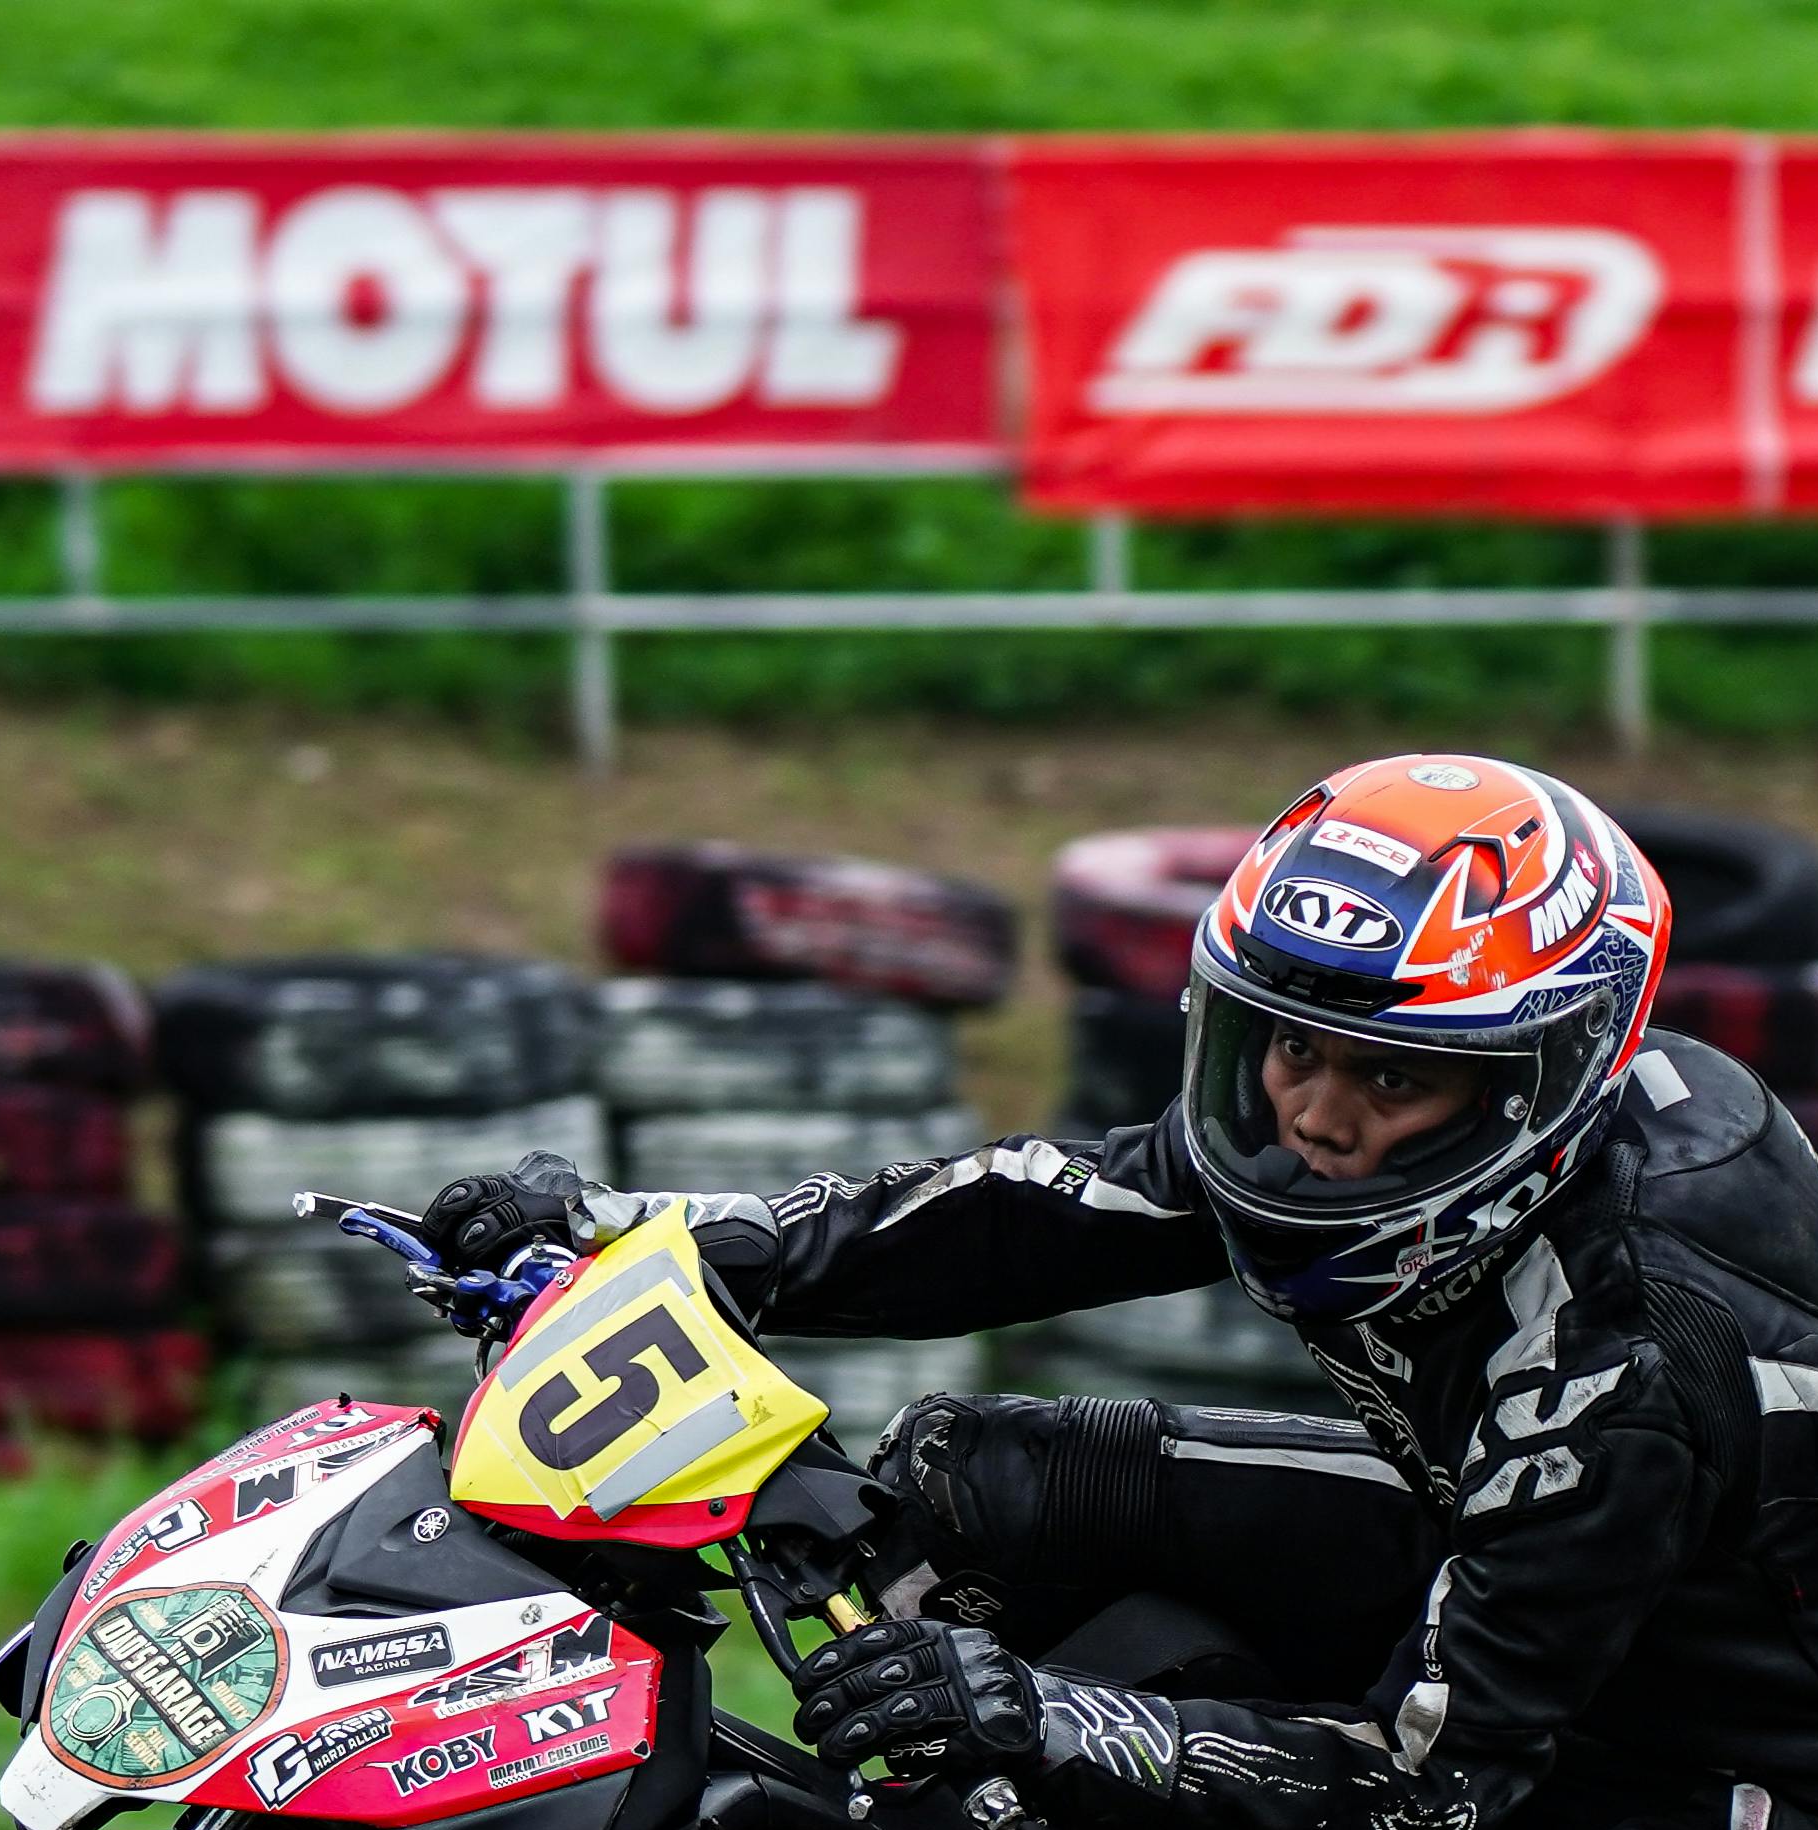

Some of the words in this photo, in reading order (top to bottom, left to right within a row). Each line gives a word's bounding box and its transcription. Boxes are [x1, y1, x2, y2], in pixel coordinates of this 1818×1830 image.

[29, 186, 904, 413] MOTUL
[1271, 883, 1390, 939] KYT
[520, 1304, 709, 1471] 5
[317, 1631, 447, 1673] NAMSSA
[354, 1658, 411, 1676] RACING
[134, 1654, 227, 1747] GARAGE
[519, 1685, 620, 1743] KYT
[313, 1745, 347, 1772] HARD
[349, 1724, 387, 1750] ALLOY
[392, 1727, 496, 1796] KOBY
[548, 1734, 609, 1762] CUSTOMS
